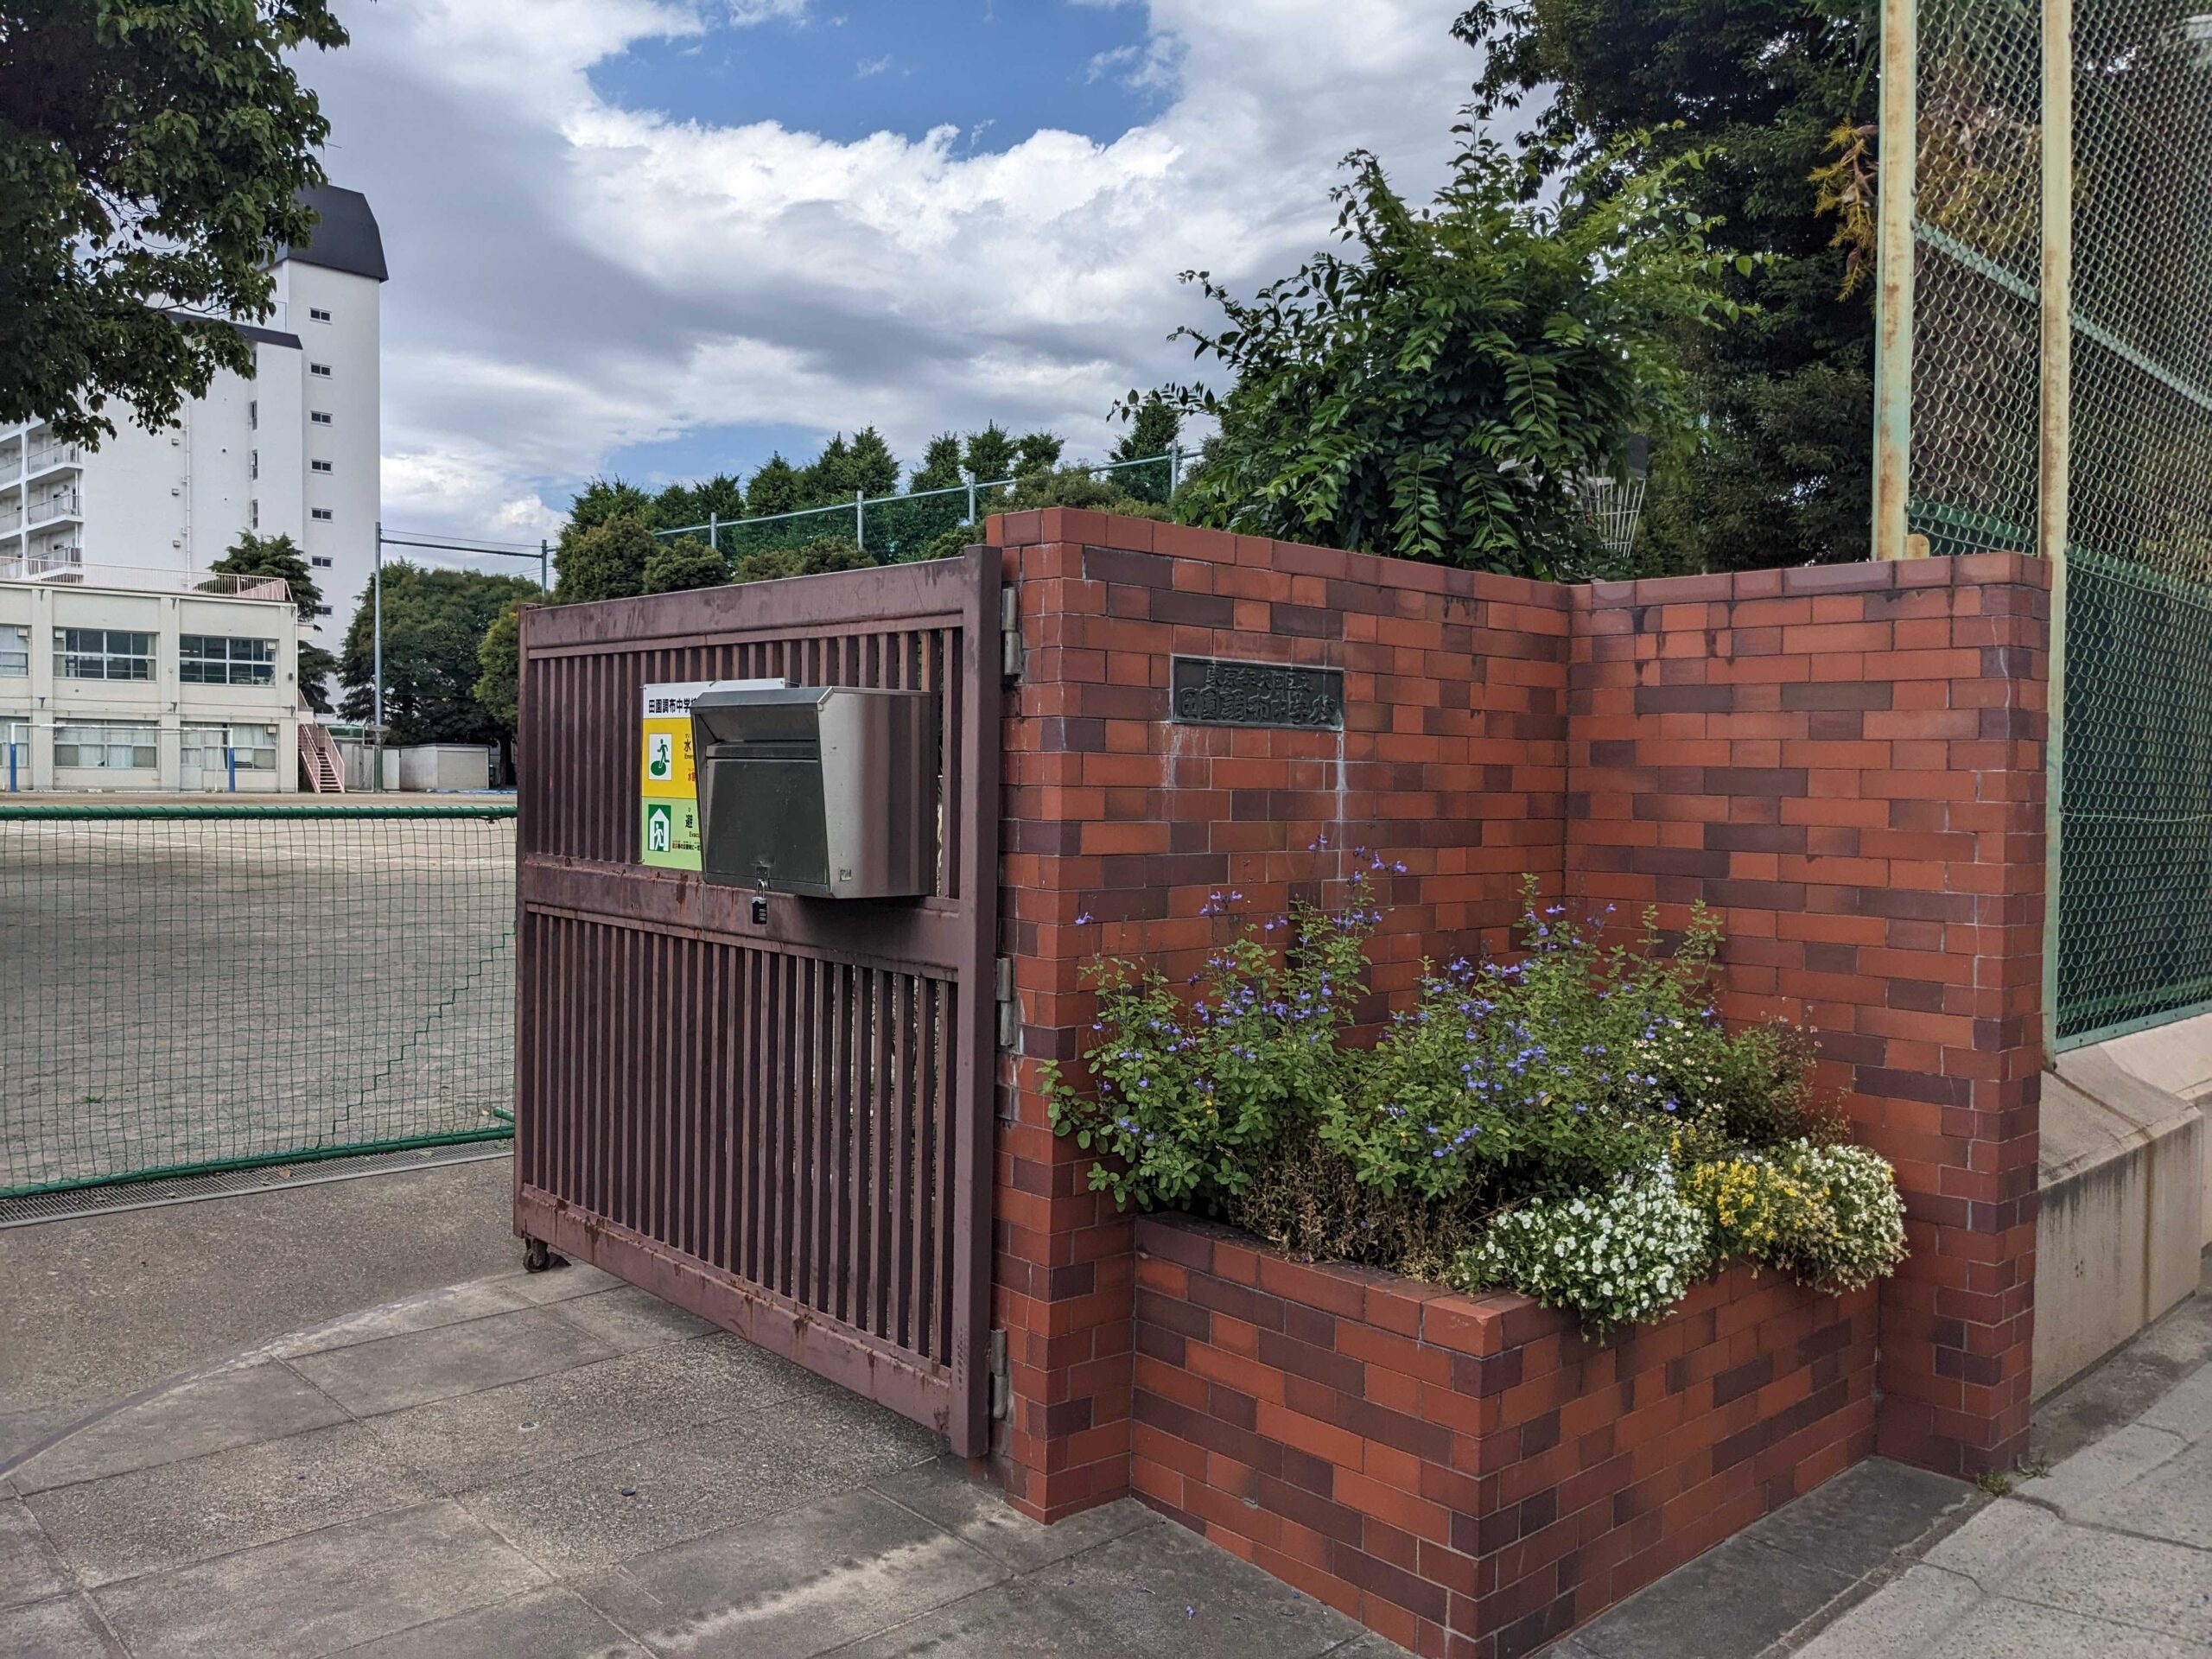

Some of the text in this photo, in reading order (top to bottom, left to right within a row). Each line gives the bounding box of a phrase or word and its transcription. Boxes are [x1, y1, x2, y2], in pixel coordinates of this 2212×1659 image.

[1179, 685, 1336, 725] 田園調布中学校
[684, 739, 691, 752] 水
